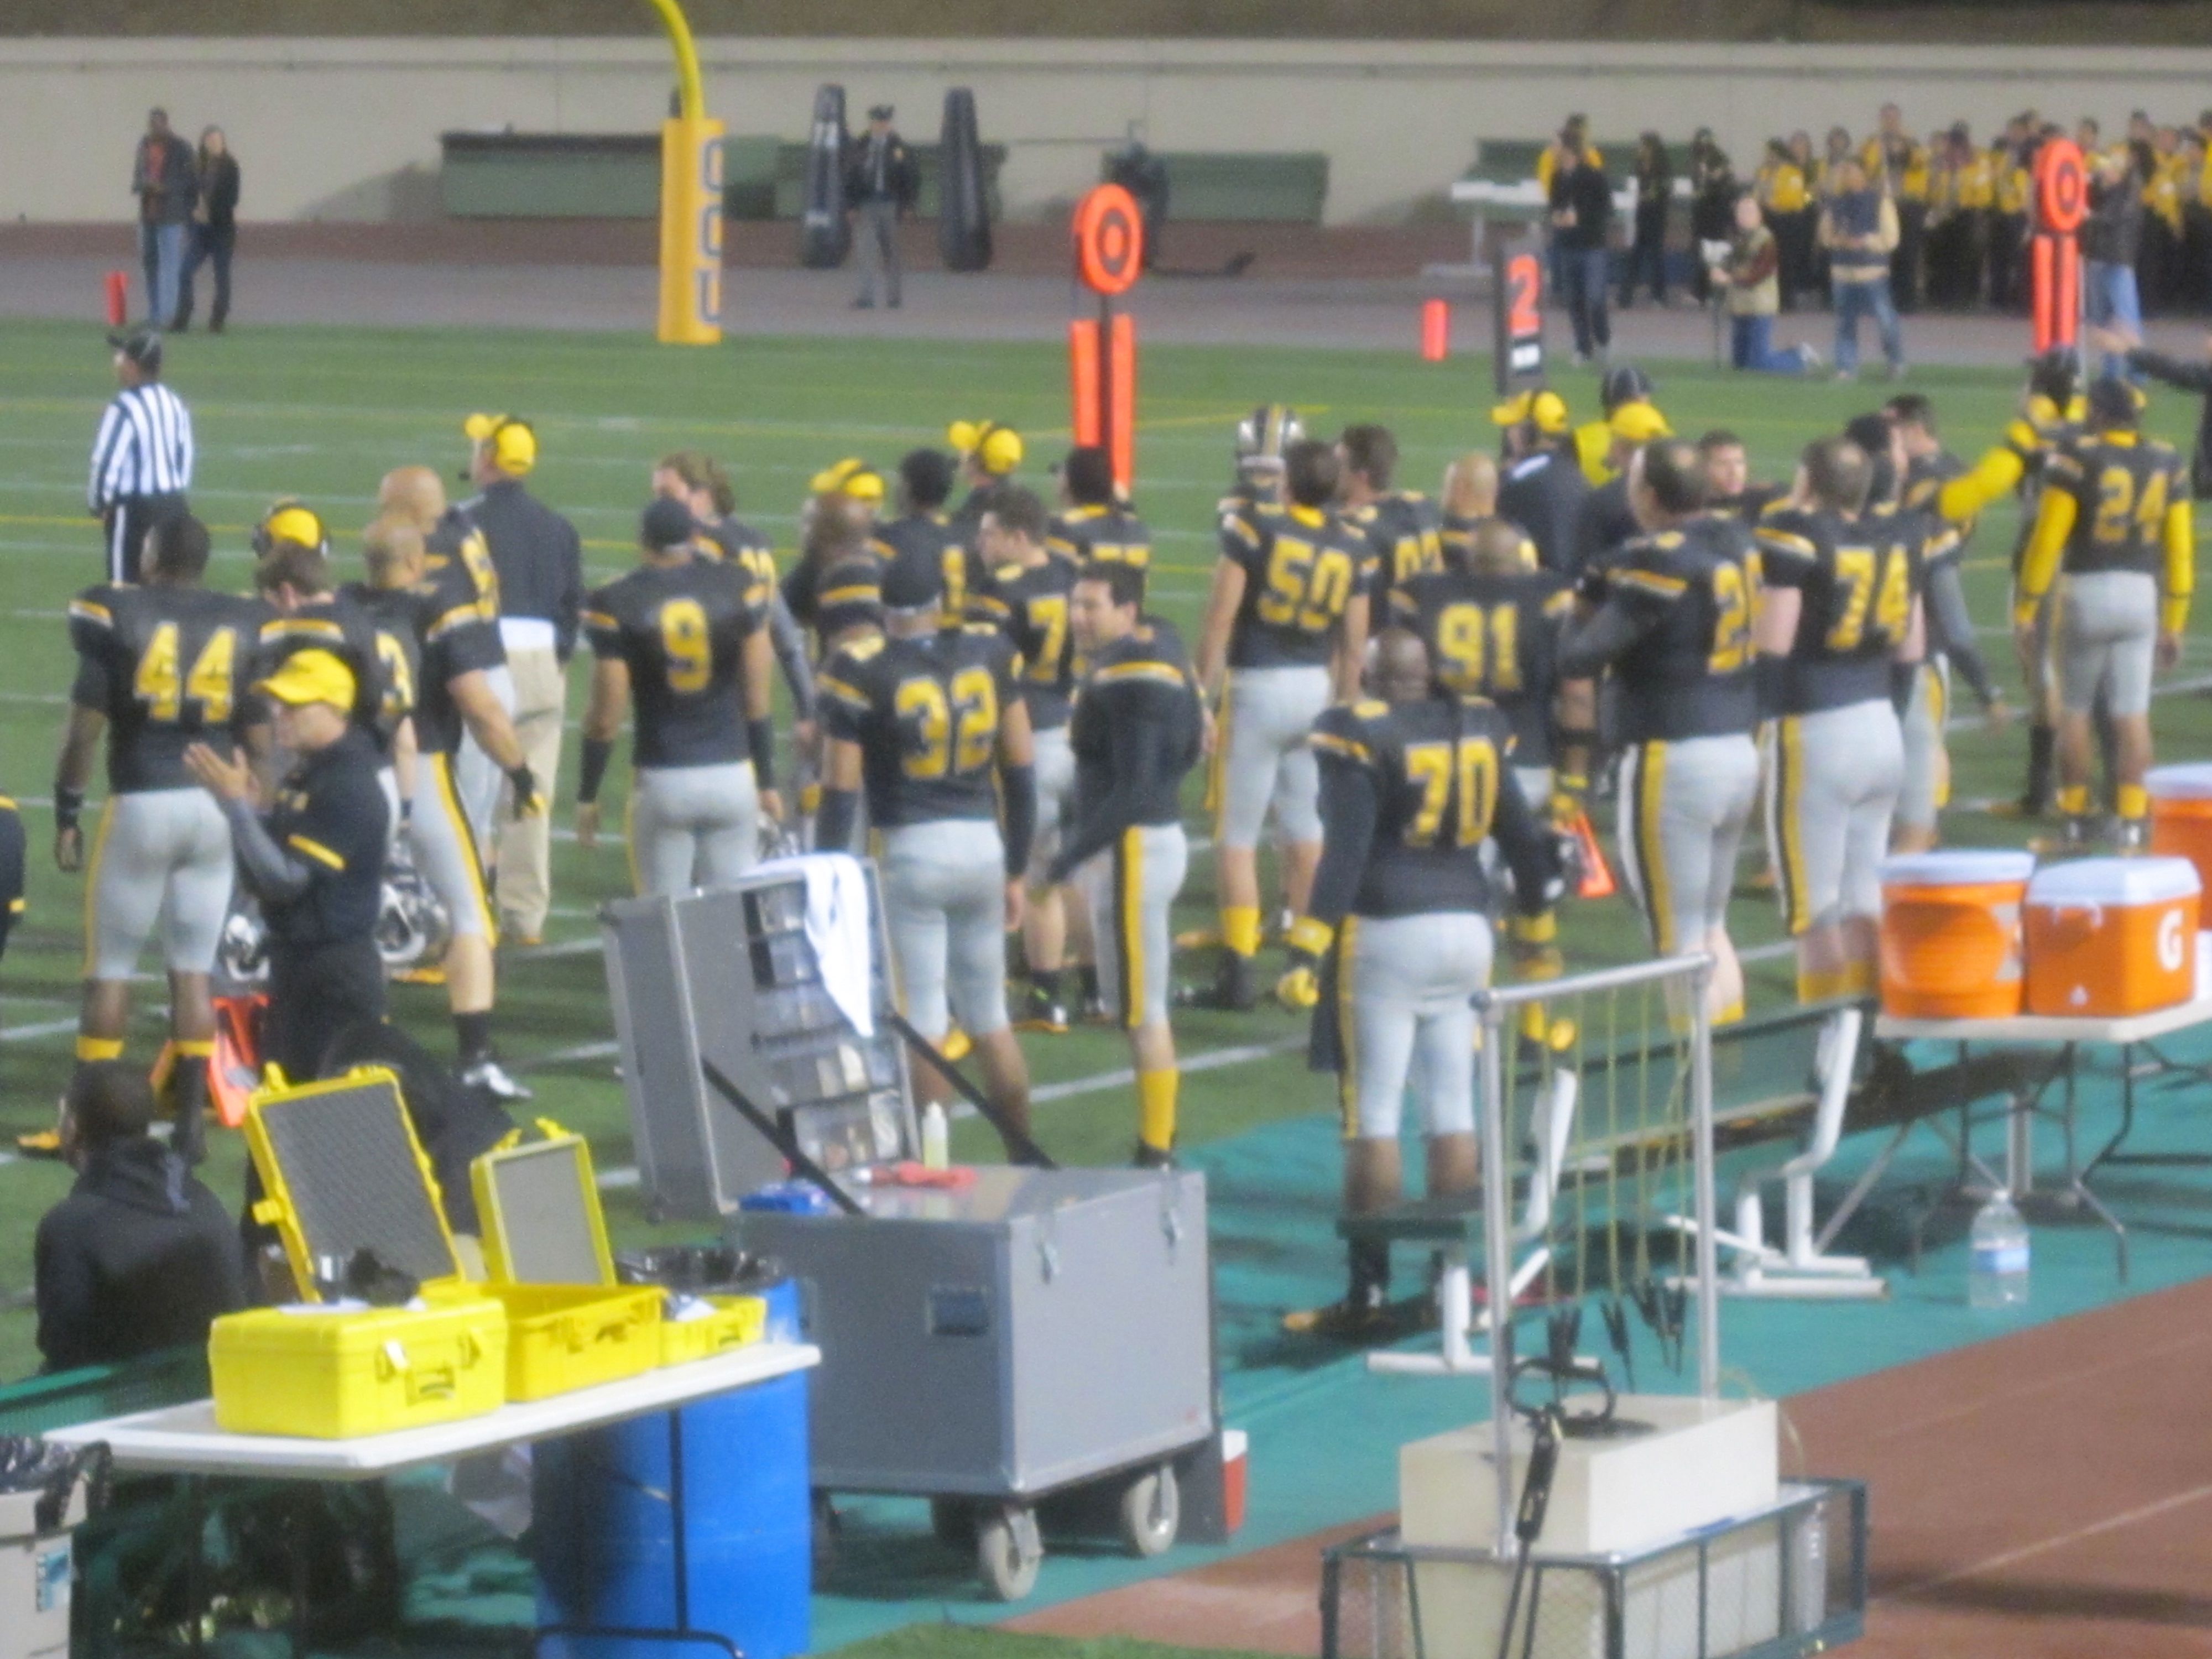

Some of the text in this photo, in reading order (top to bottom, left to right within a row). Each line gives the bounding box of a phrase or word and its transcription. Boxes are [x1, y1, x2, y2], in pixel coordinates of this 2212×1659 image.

[1509, 254, 1540, 337] 2
[2093, 467, 2167, 545] 24
[1257, 535, 1353, 632] 50
[1825, 544, 1910, 651] 74
[132, 620, 236, 723] 44
[660, 596, 711, 695] 9
[1437, 600, 1522, 692] 91
[894, 665, 997, 779] 32
[1402, 735, 1499, 848] 70
[2158, 909, 2183, 971] G
